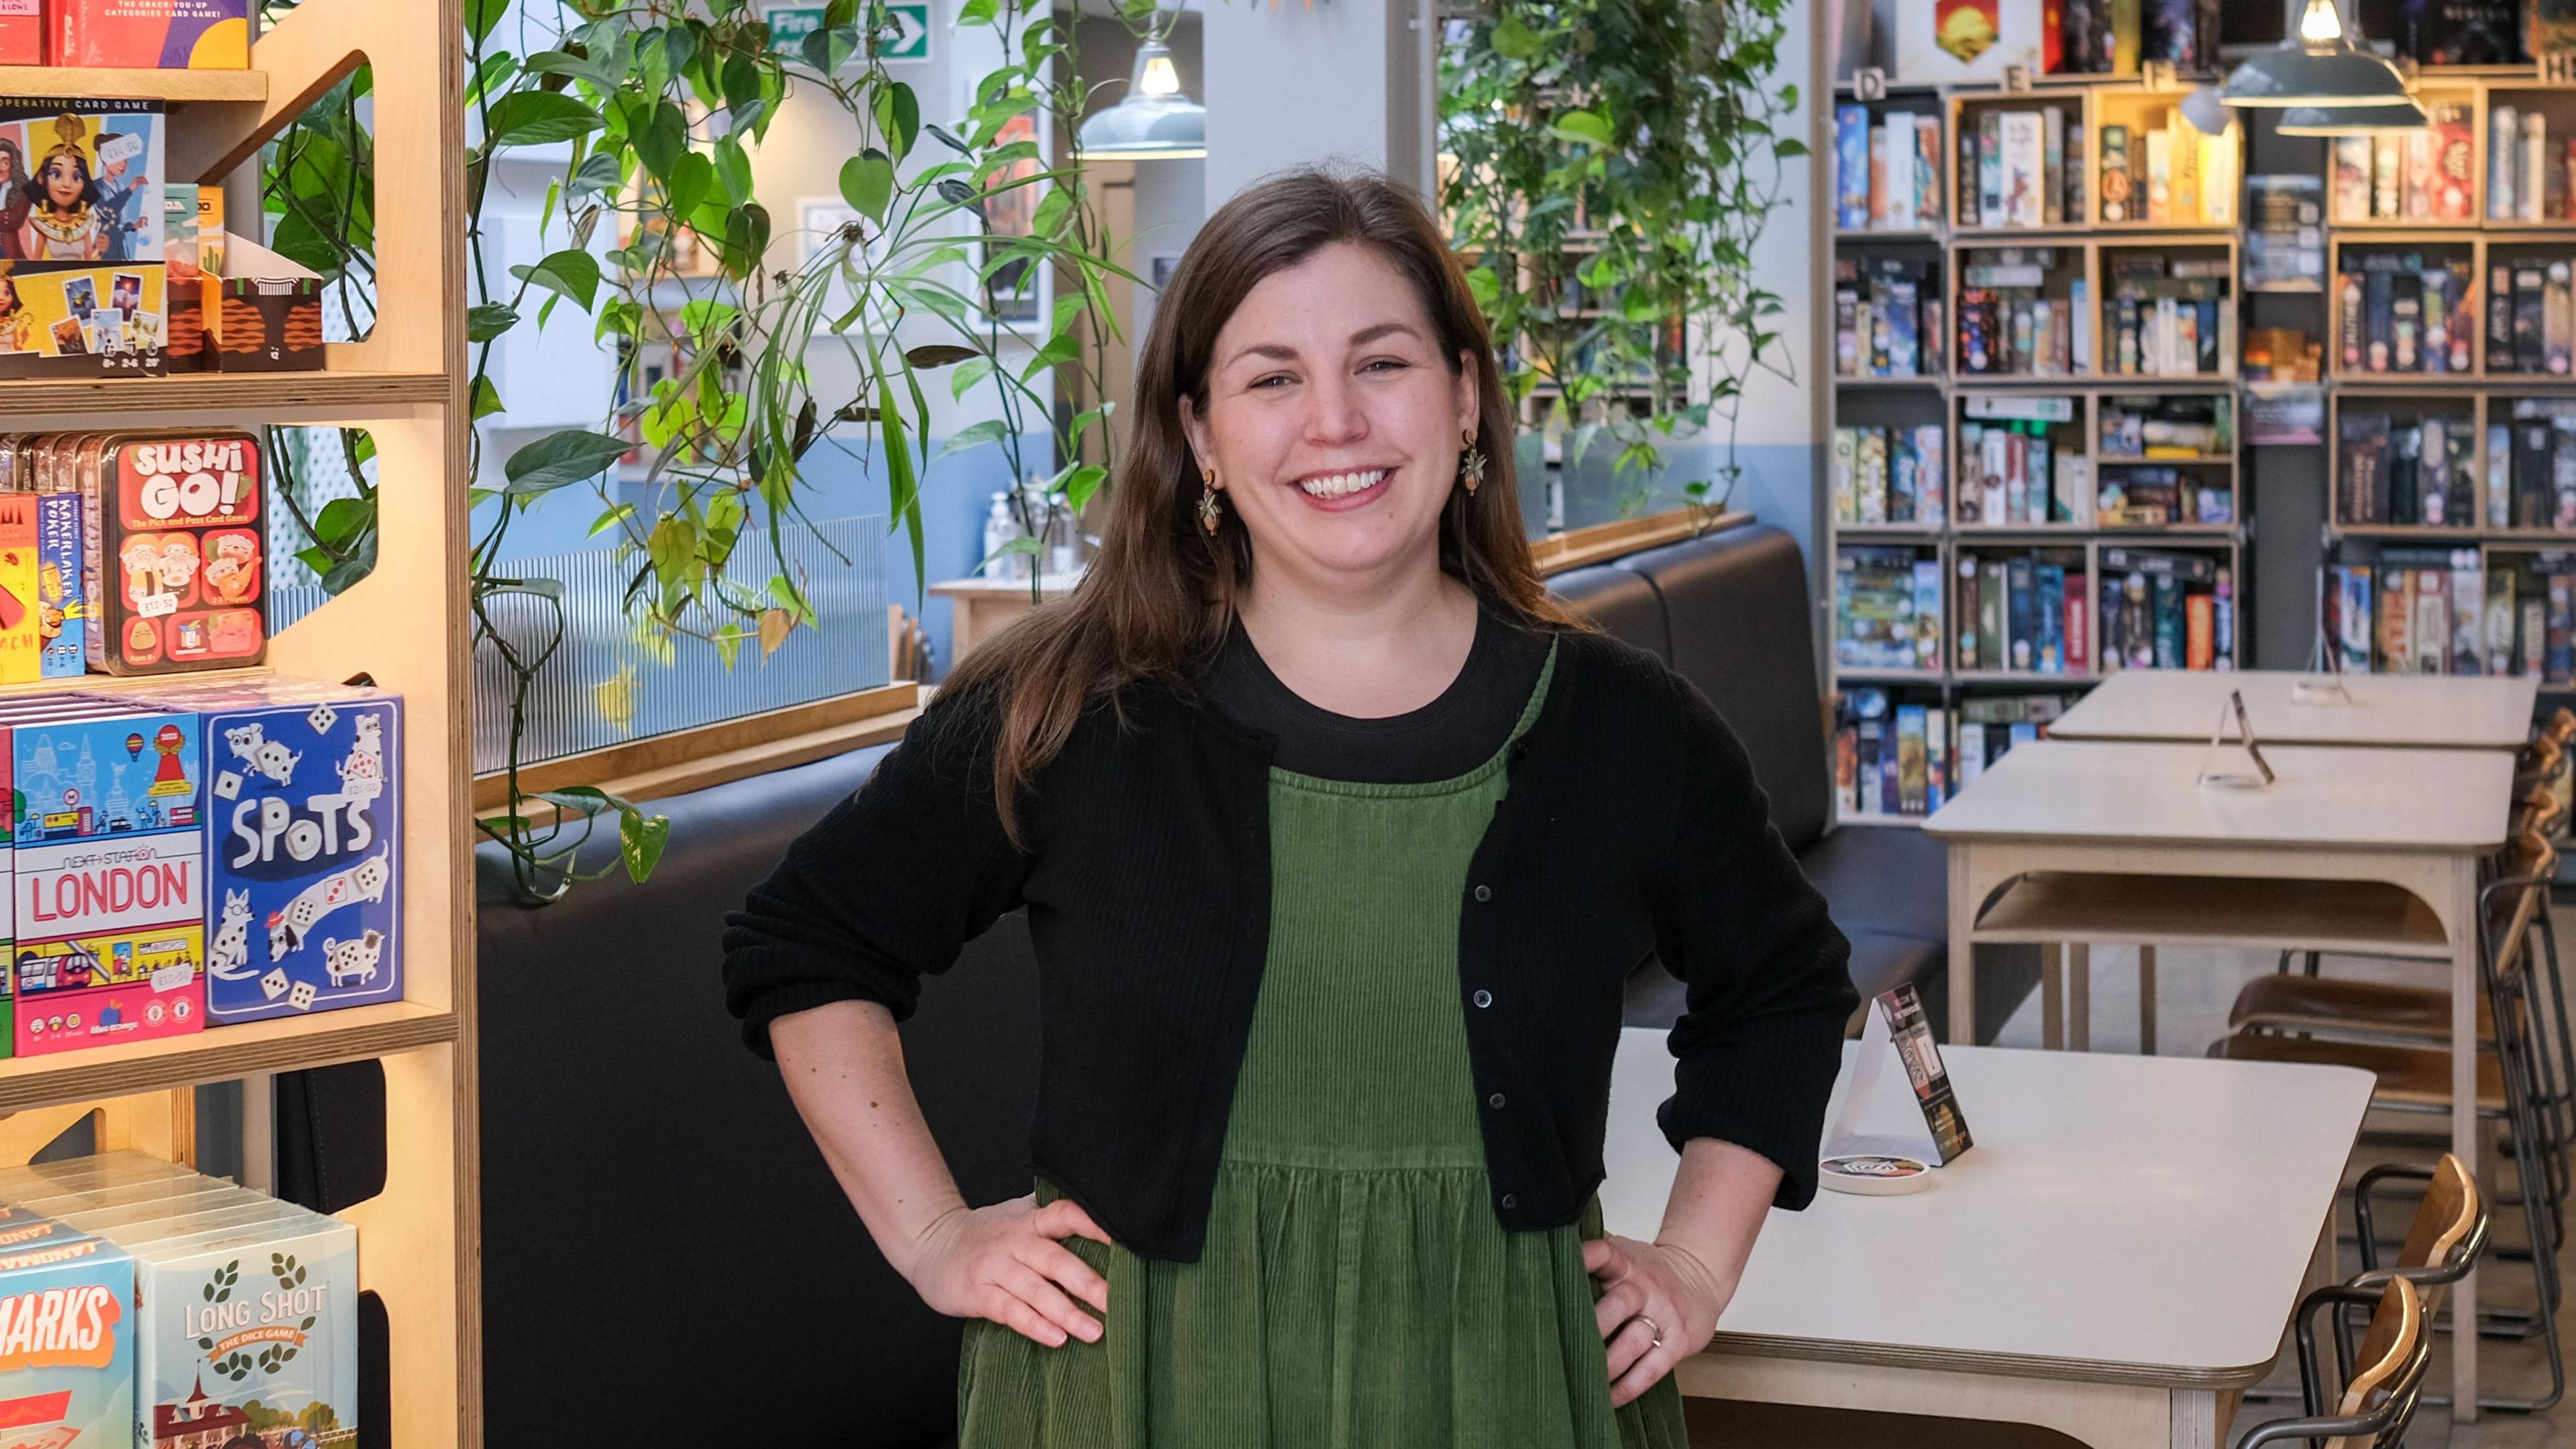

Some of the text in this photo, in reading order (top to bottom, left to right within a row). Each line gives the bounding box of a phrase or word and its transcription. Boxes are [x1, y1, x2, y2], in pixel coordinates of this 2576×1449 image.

[139, 1, 208, 9] CRACK-YOU-UP
[773, 11, 818, 34] Fire
[74, 101, 108, 110] CARD
[114, 101, 150, 110] GAME
[140, 471, 240, 519] GO!
[46, 500, 60, 551] POKER
[132, 514, 249, 527] The Pick and Pass Card Game
[58, 499, 74, 598] KAKERLAKEN
[231, 794, 372, 869] SPOTS
[63, 855, 97, 869] NEXT
[32, 861, 187, 922] LONDON
[184, 1284, 327, 1340] LONG SHOT
[219, 1329, 295, 1351] THE DICE GAME
